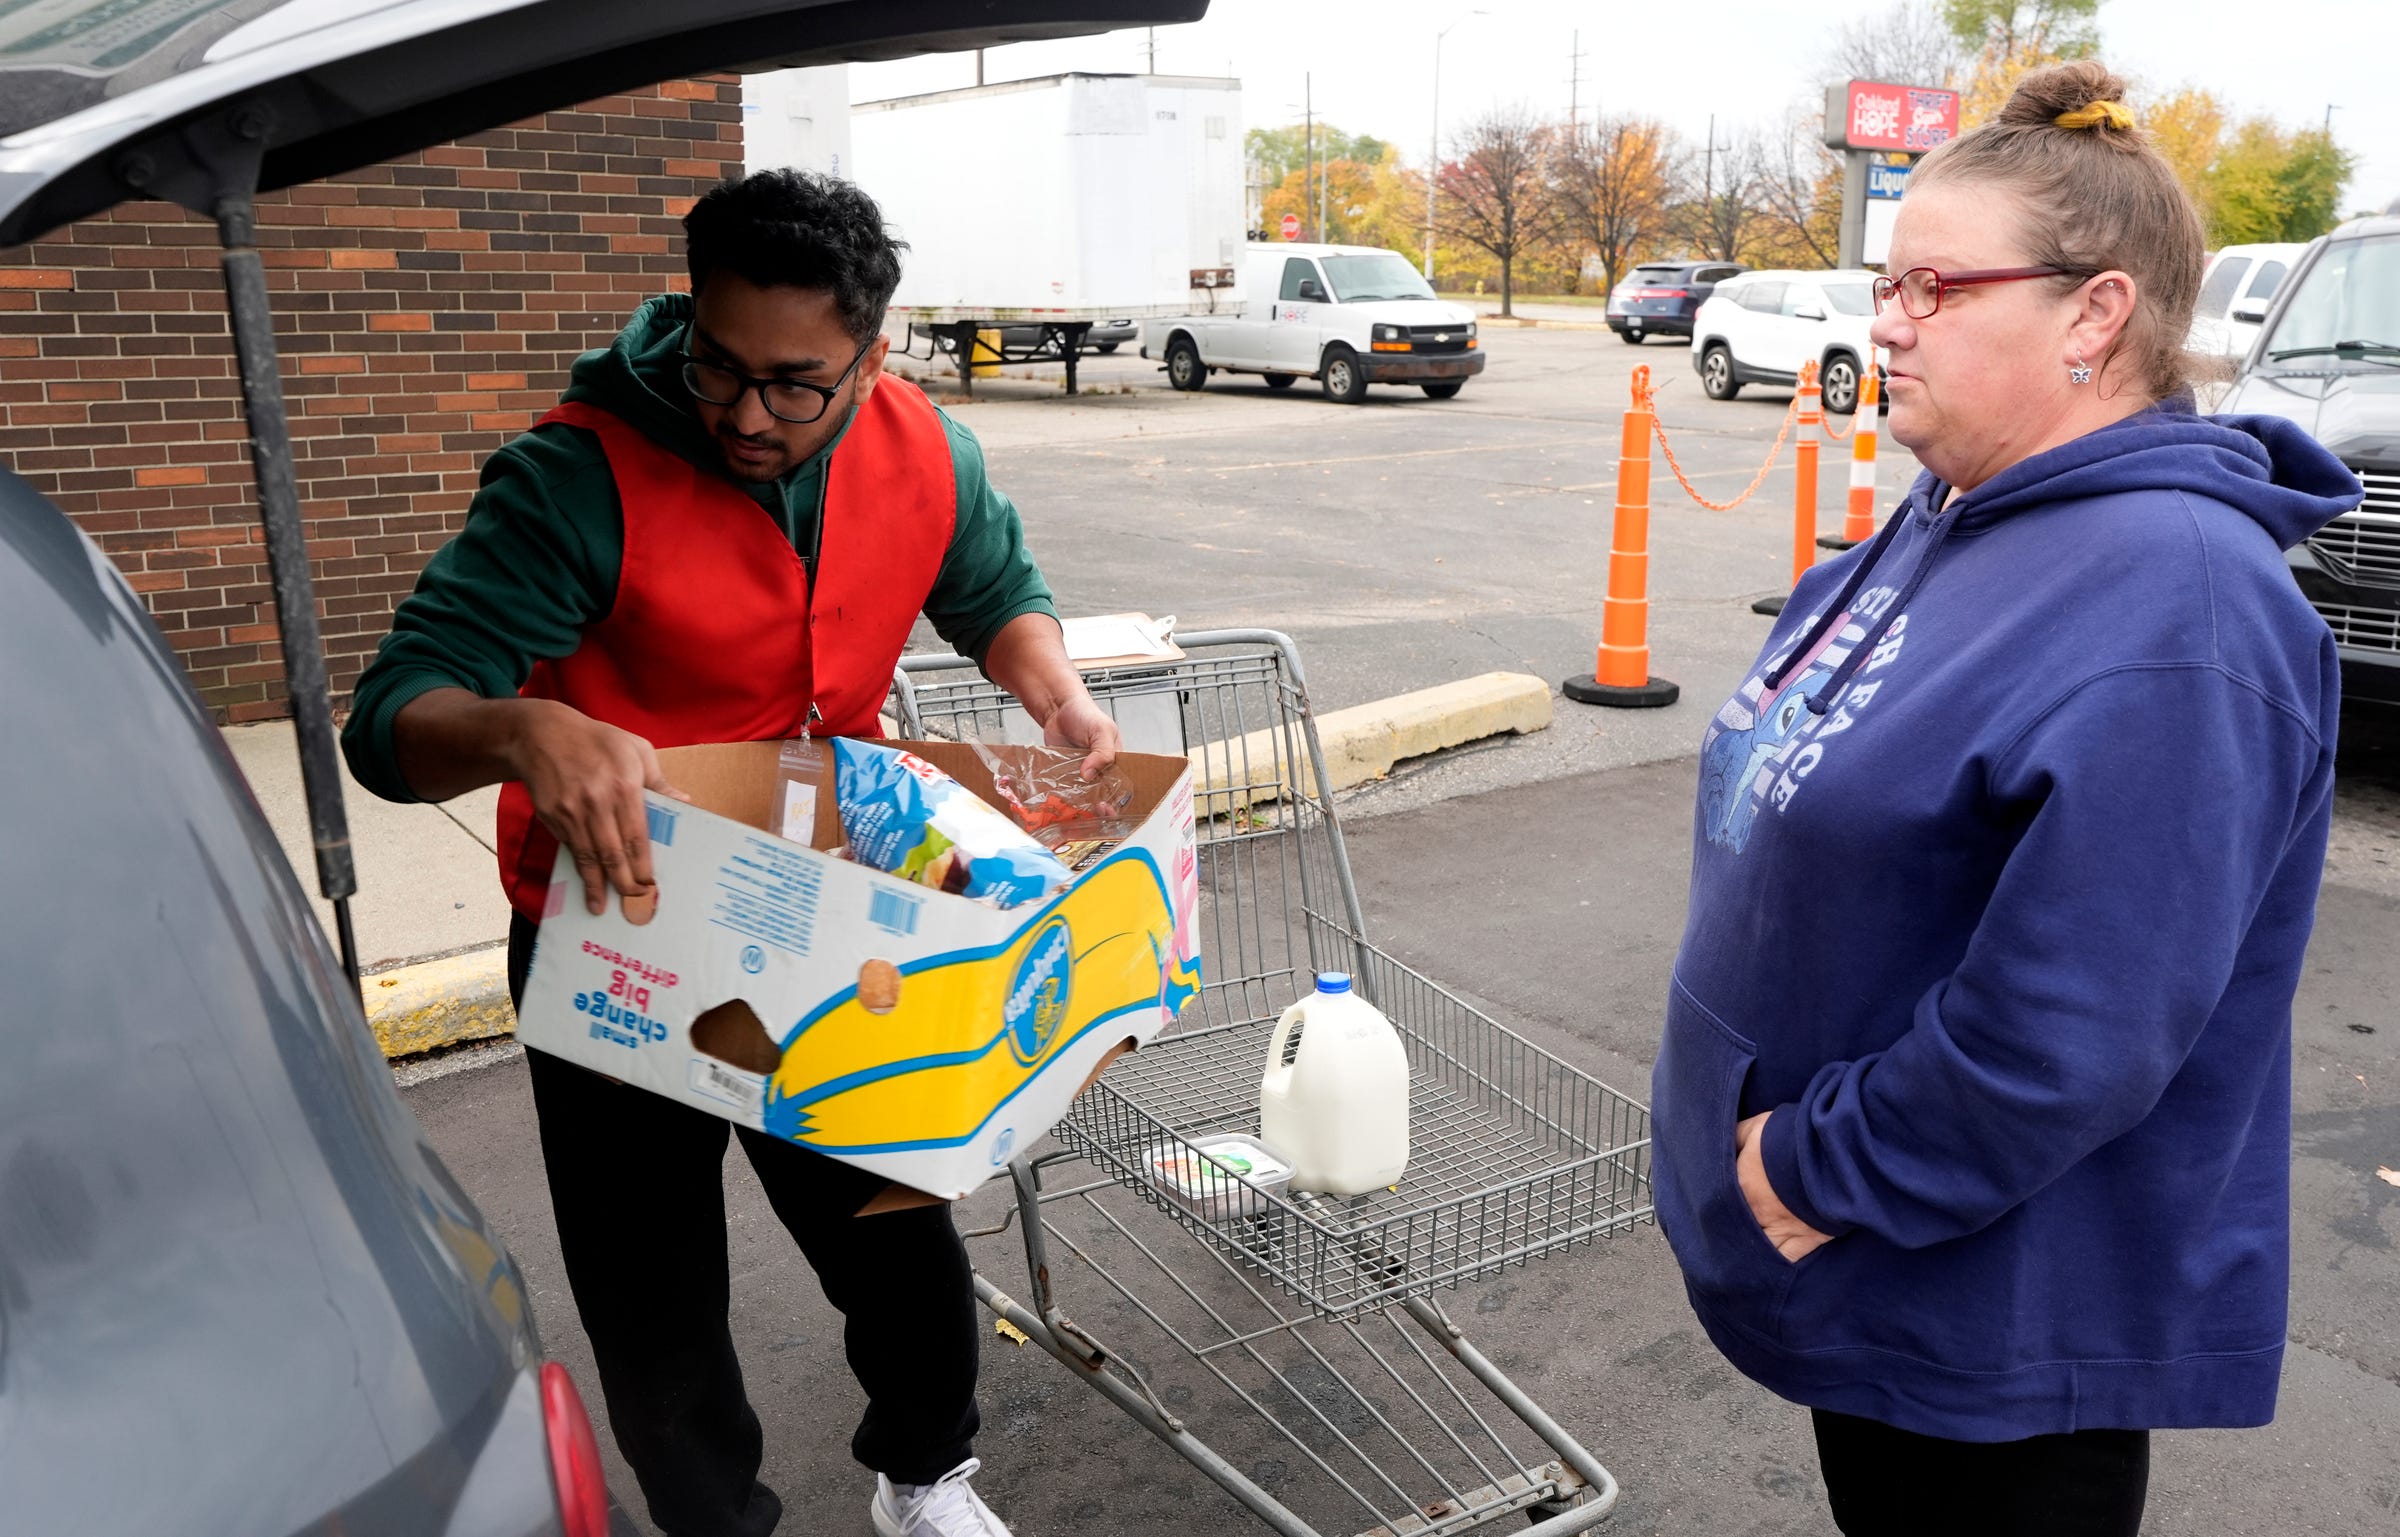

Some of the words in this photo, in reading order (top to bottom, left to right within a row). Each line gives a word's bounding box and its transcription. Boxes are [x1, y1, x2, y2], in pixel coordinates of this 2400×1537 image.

[1855, 93, 1900, 112] Oakland
[1908, 91, 1951, 114] THRIFT
[1853, 109, 1899, 138] HOPE
[1905, 127, 1949, 148] STORE
[1850, 586, 1908, 674] STICH
[1771, 679, 1883, 813] FACE
[582, 940, 679, 988] difference
[608, 969, 650, 1013] big
[574, 991, 667, 1043] change
[588, 1021, 638, 1049] small
